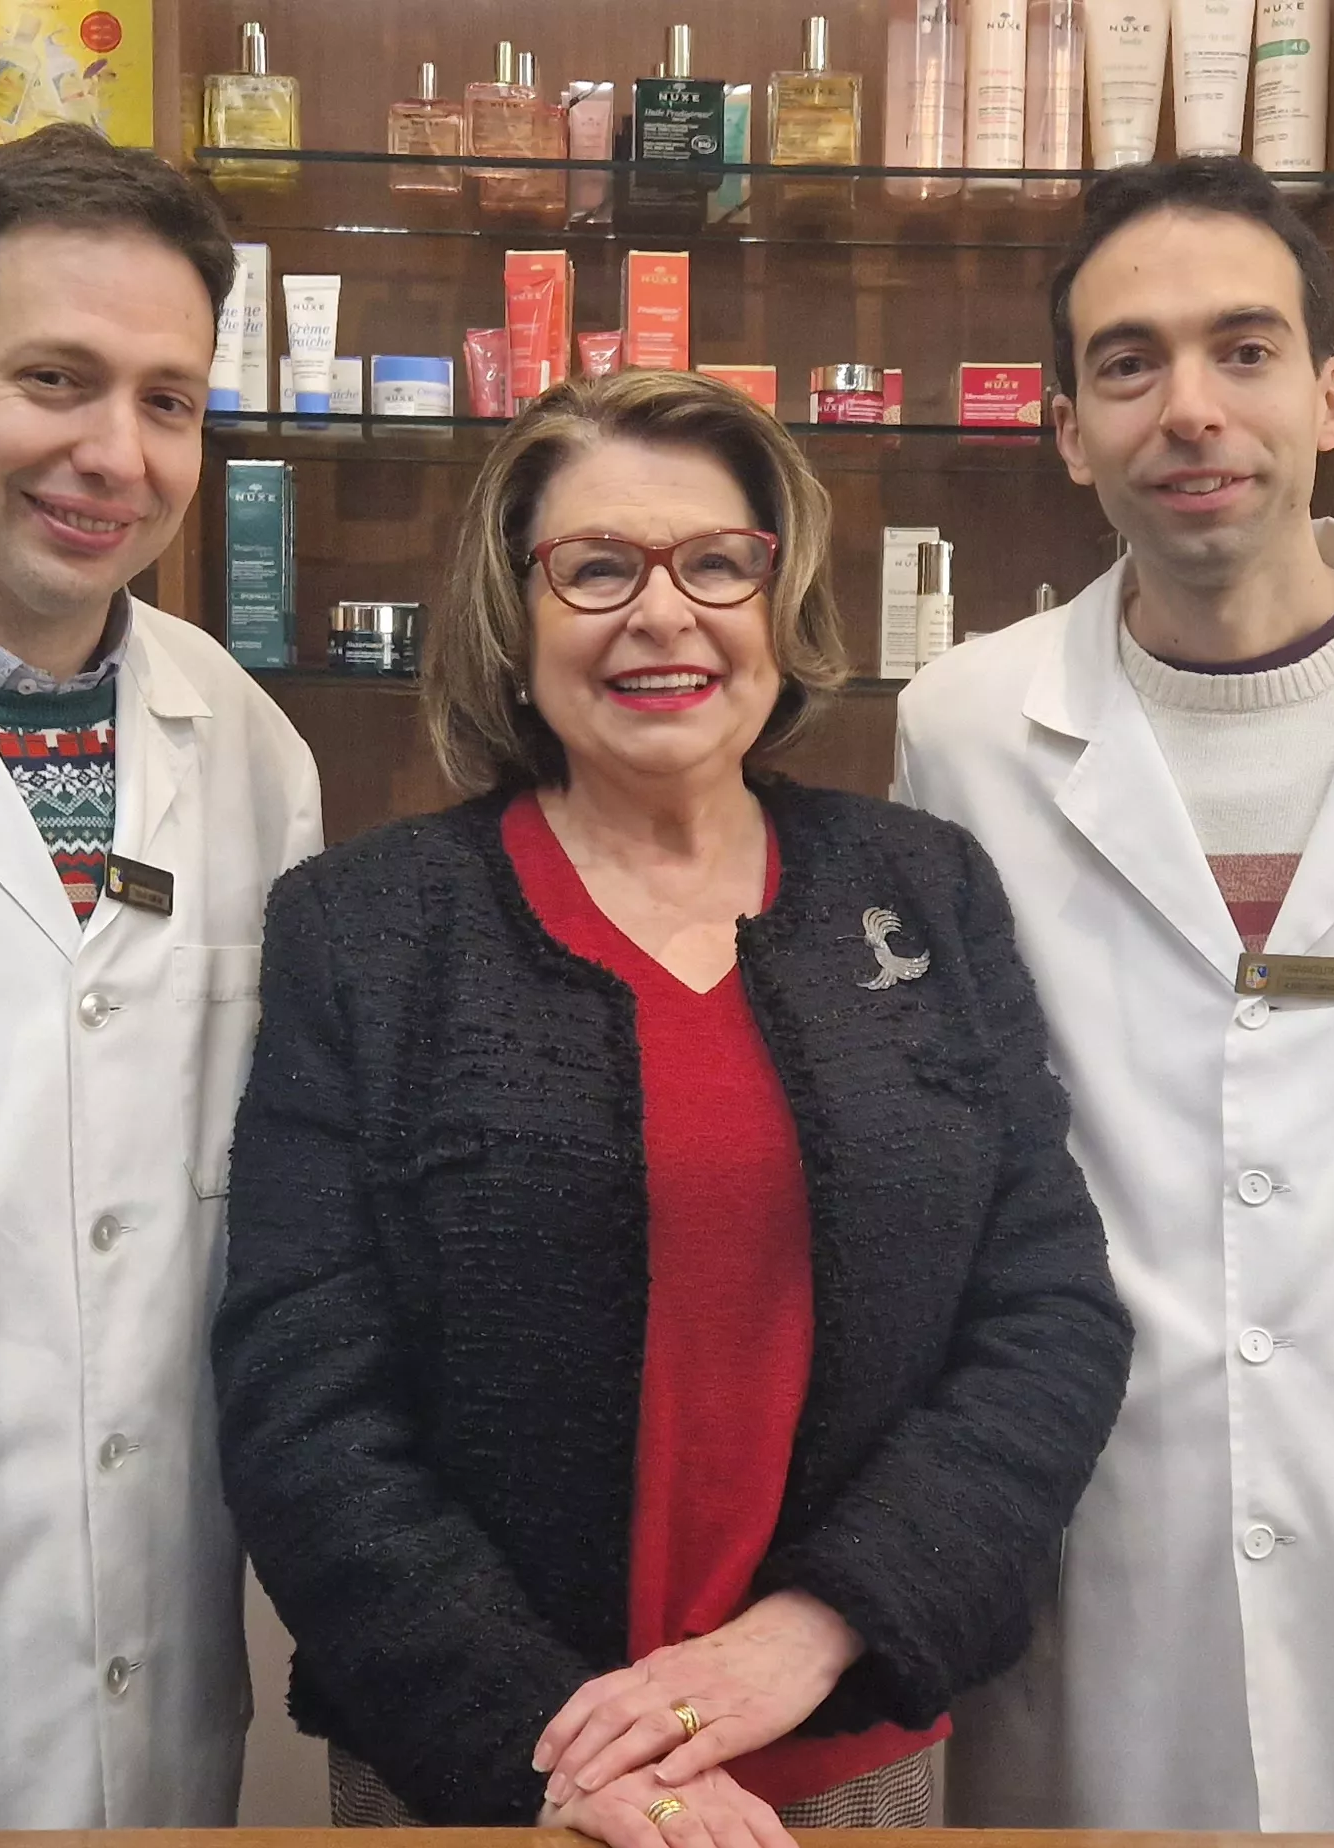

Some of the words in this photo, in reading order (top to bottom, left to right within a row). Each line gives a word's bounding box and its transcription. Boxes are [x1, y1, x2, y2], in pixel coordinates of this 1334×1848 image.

[1263, 2, 1305, 14] NUXE
[986, 22, 1021, 31] NUXE
[1271, 16, 1295, 28] body
[1109, 25, 1151, 33] NUXE
[658, 91, 701, 102] NUXE
[641, 275, 679, 284] NUXE
[289, 322, 330, 336] Crème
[235, 494, 276, 502] NUXE
